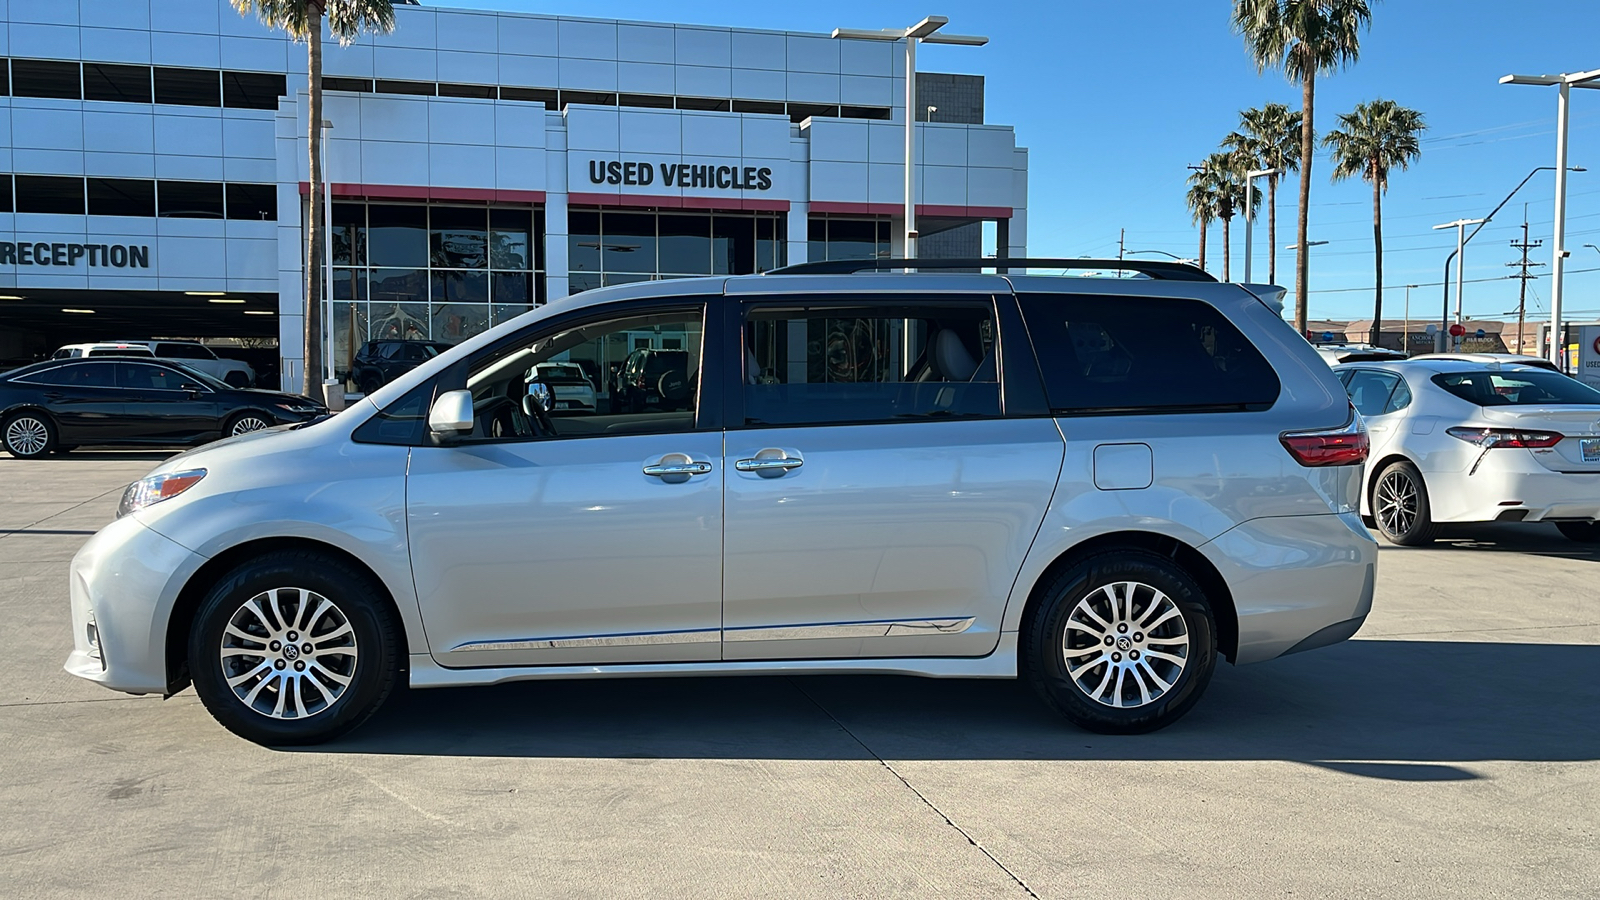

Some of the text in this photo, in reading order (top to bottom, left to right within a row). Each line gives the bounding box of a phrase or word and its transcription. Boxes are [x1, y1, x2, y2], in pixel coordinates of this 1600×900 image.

[589, 160, 772, 190] USED VEHICLES
[0, 241, 149, 268] RECEPTION
